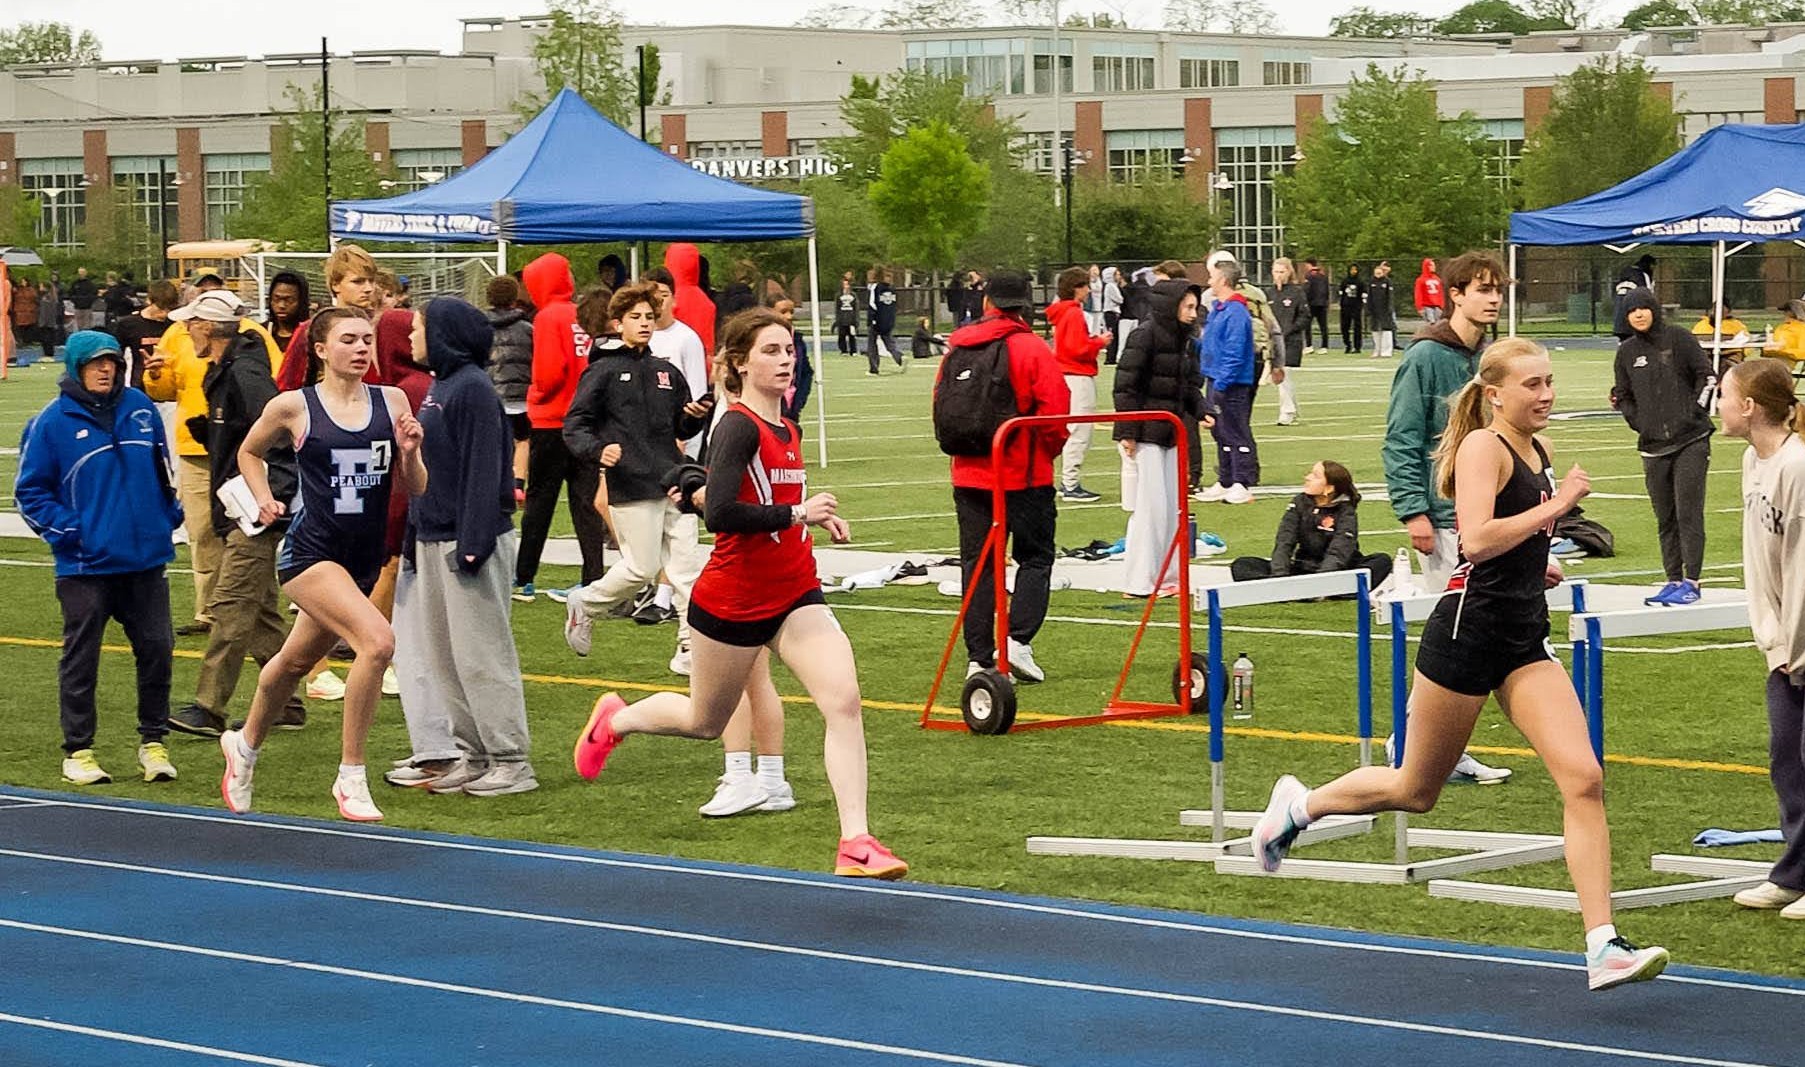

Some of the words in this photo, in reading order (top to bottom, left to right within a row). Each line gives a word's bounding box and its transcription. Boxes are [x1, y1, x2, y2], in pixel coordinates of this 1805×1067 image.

[800, 157, 853, 176] HIG
[375, 444, 387, 471] 1
[330, 474, 382, 488] PEABODY
